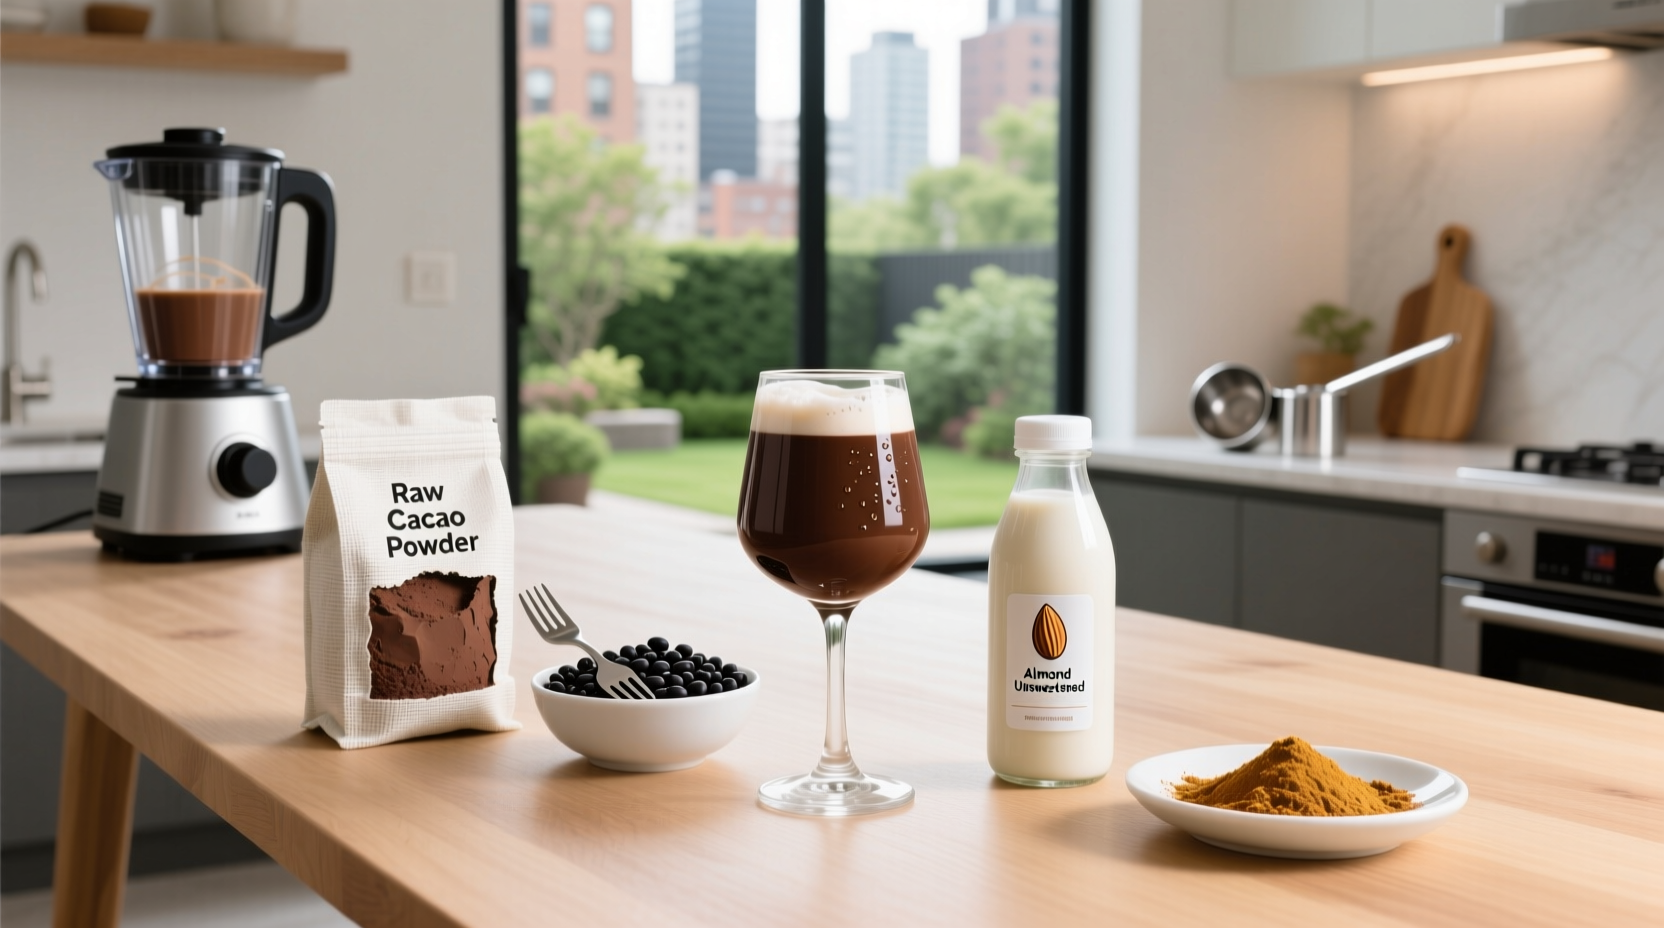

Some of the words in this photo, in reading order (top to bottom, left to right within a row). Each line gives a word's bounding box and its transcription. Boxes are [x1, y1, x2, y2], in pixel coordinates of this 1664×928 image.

[391, 482, 444, 504] Raw
[387, 508, 466, 531] Cacao
[386, 532, 479, 558] Powder
[1023, 666, 1072, 680] Almond
